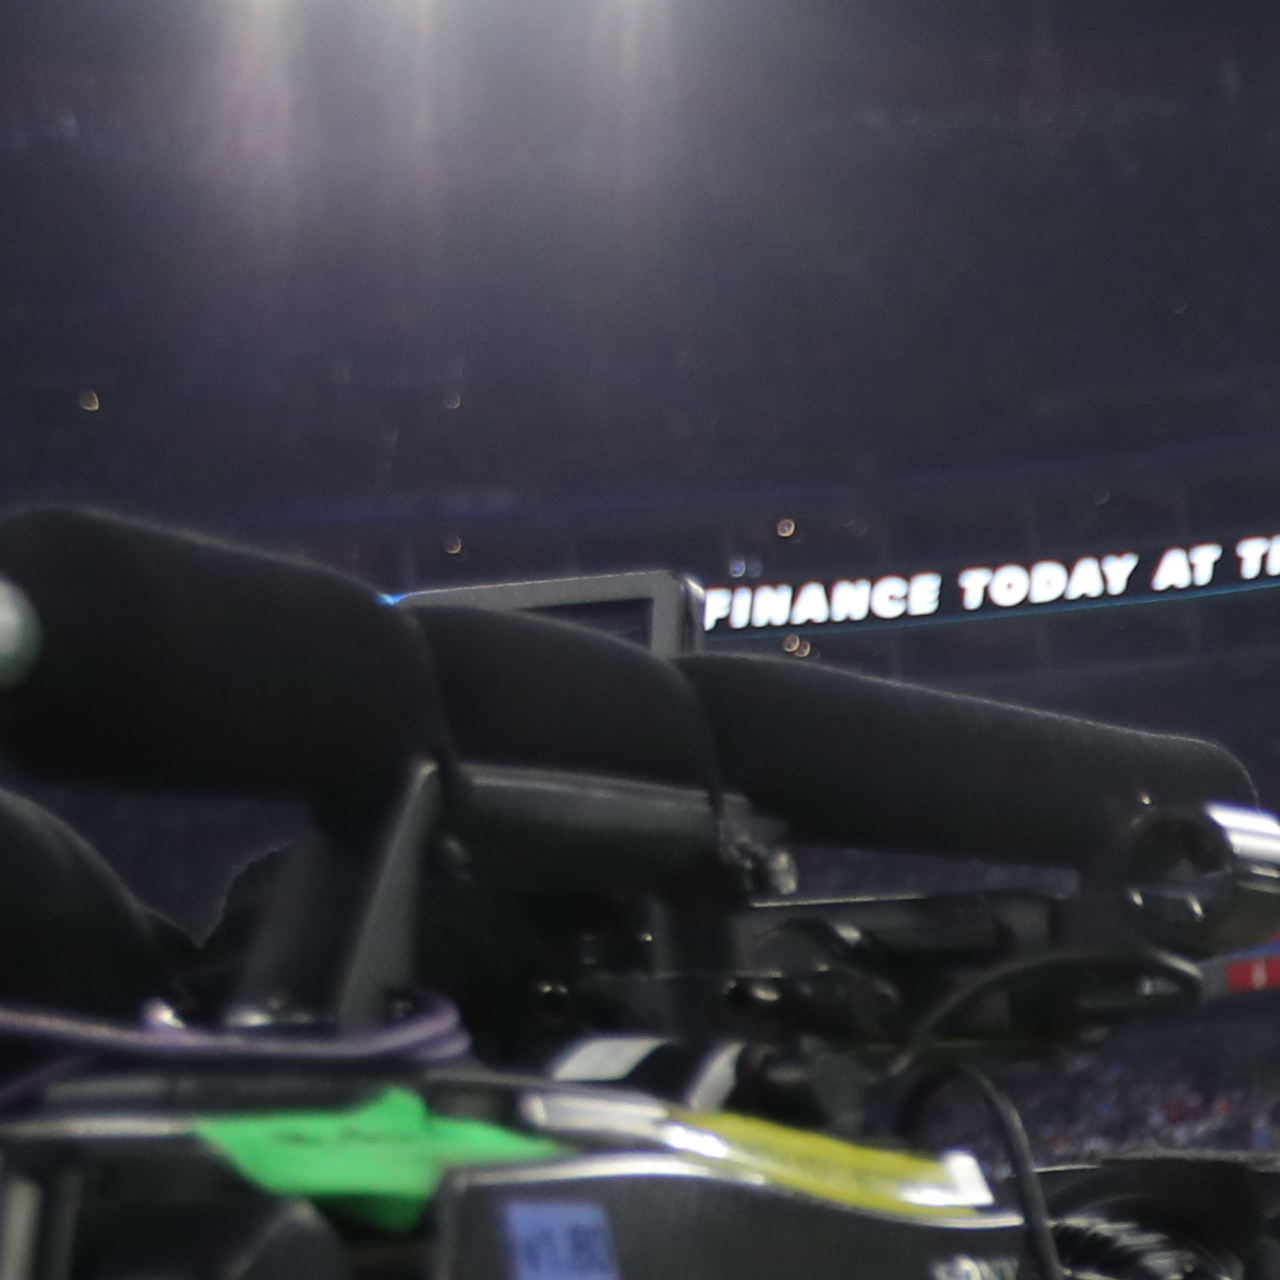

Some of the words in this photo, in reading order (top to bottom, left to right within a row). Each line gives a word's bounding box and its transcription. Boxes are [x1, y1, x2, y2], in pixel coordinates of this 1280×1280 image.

[704, 573, 942, 630] FINANCE
[958, 552, 1138, 610] TODAY
[1152, 543, 1222, 591] AT
